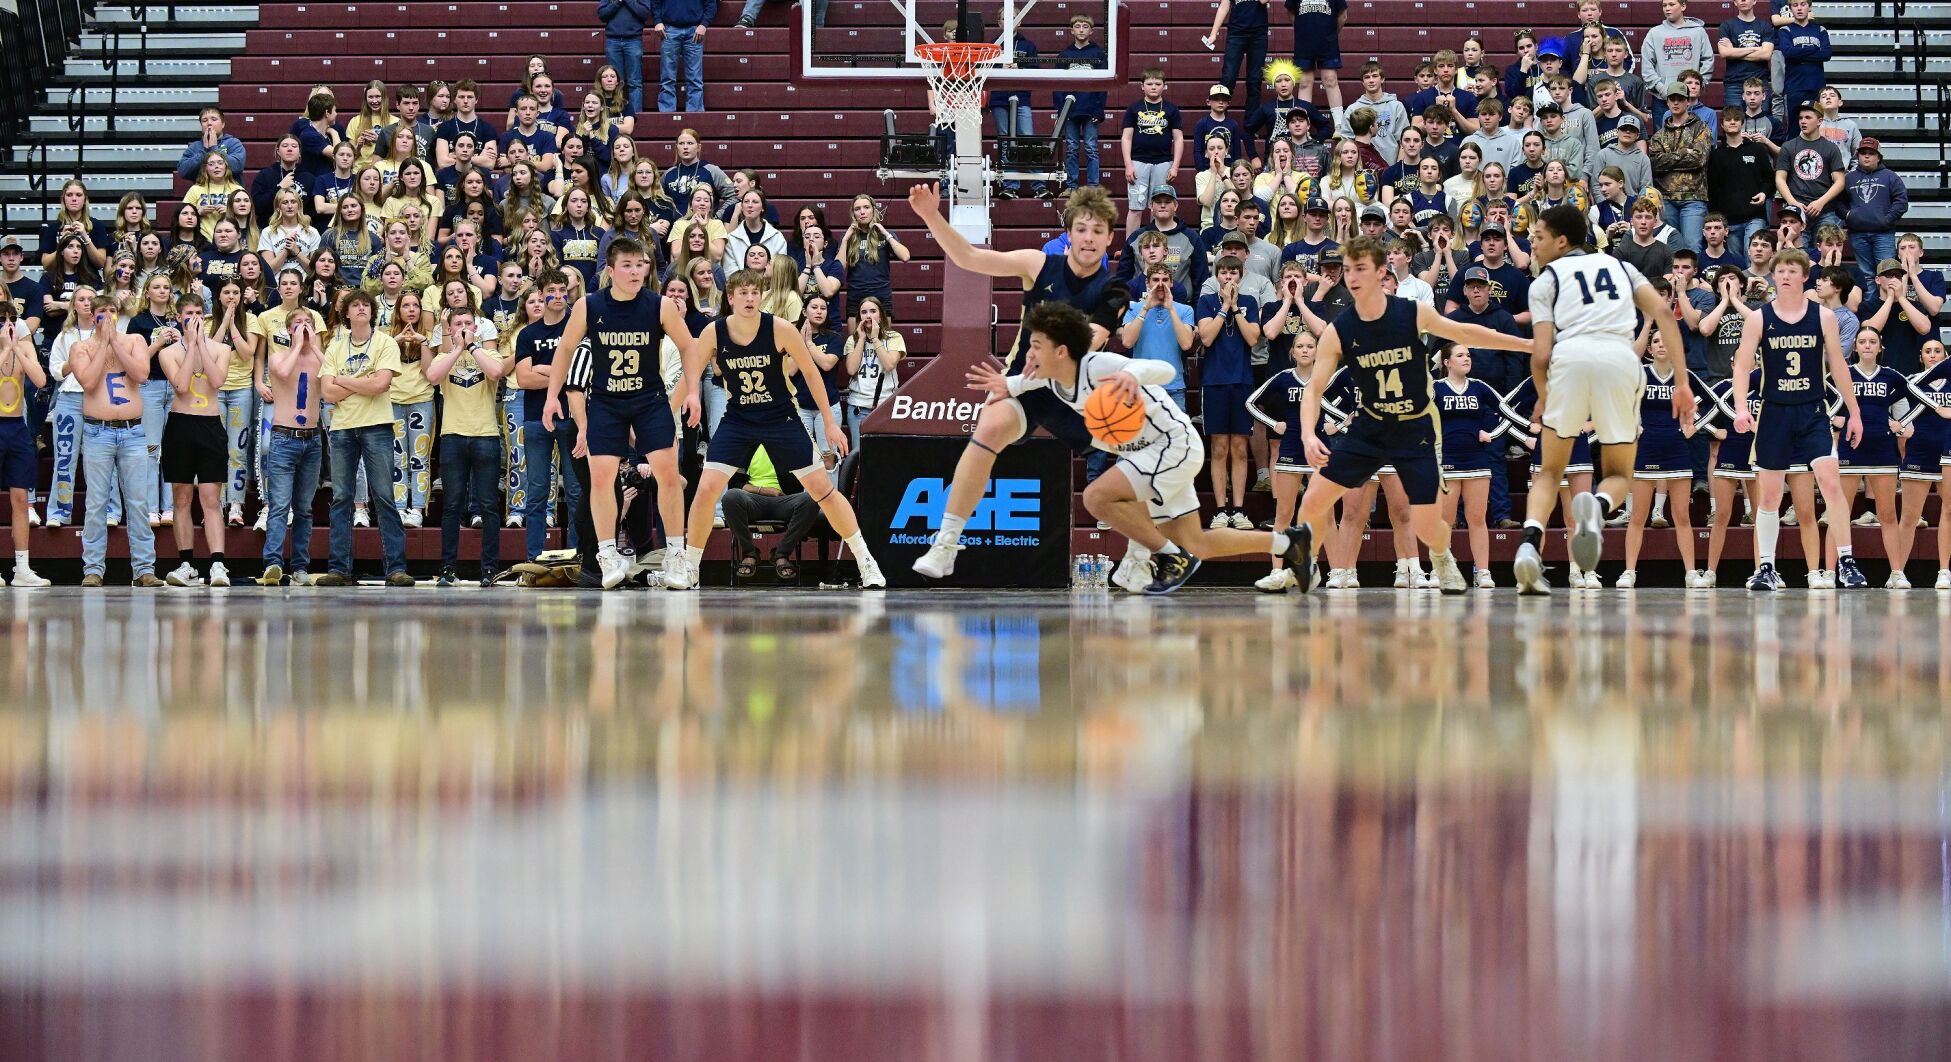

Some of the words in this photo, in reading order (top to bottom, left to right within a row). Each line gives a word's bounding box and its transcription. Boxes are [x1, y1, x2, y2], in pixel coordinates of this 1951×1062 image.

[1574, 267, 1620, 305] 14
[598, 332, 649, 346] WOODEN
[1768, 335, 1817, 349] WOODEN
[608, 350, 640, 376] 23
[726, 355, 771, 370] WOODEN
[1356, 346, 1412, 368] WOODEN
[1785, 351, 1802, 376] 3
[858, 364, 880, 379] 43
[105, 371, 131, 406] E
[189, 373, 209, 408] S
[607, 377, 643, 392] SHOES
[738, 370, 767, 394] 32
[1375, 368, 1404, 399] 14
[1777, 377, 1811, 392] SHOES
[1852, 382, 1888, 397] THS
[739, 392, 773, 405] SHOES
[1646, 384, 1676, 400] TH
[891, 395, 984, 421] Banter
[1443, 395, 1479, 410] THS
[889, 533, 937, 546] Afforda
[958, 535, 982, 546] Gas
[995, 535, 1040, 547] Electric
